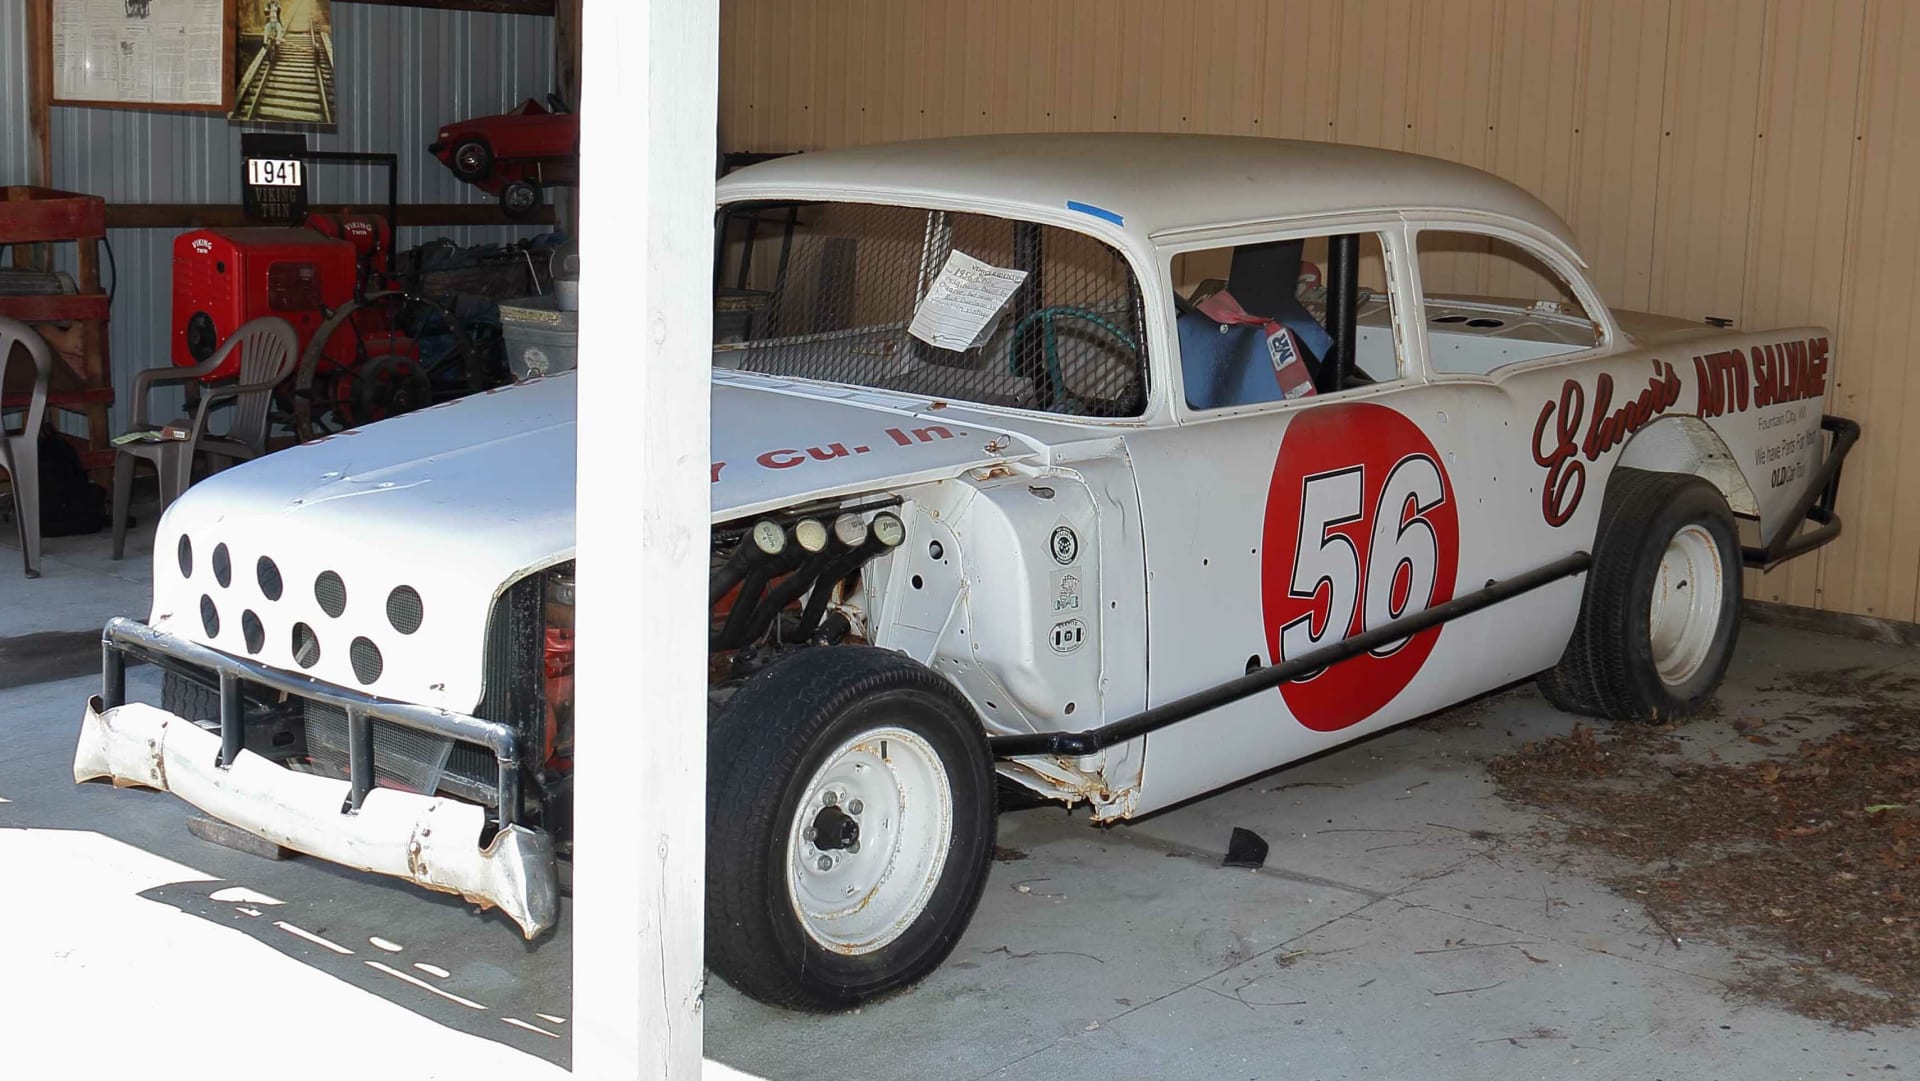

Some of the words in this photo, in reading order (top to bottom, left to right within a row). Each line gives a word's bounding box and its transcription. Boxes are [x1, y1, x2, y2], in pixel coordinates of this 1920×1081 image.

[251, 160, 297, 184] 1941
[255, 187, 297, 203] VIKING
[261, 203, 290, 218] TWIN
[344, 221, 372, 232] VIKING
[192, 239, 213, 250] VIKING
[1532, 358, 1682, 527] Elmer's
[1692, 348, 1750, 418] AUTO
[1750, 337, 1829, 409] SALVAGE
[1758, 415, 1785, 432] Fountain
[885, 424, 967, 446] In.
[1755, 446, 1766, 467] We
[1766, 445, 1781, 463] have
[1781, 439, 1796, 457] Parts
[1771, 466, 1787, 489] OLD
[1280, 452, 1446, 684] 56
